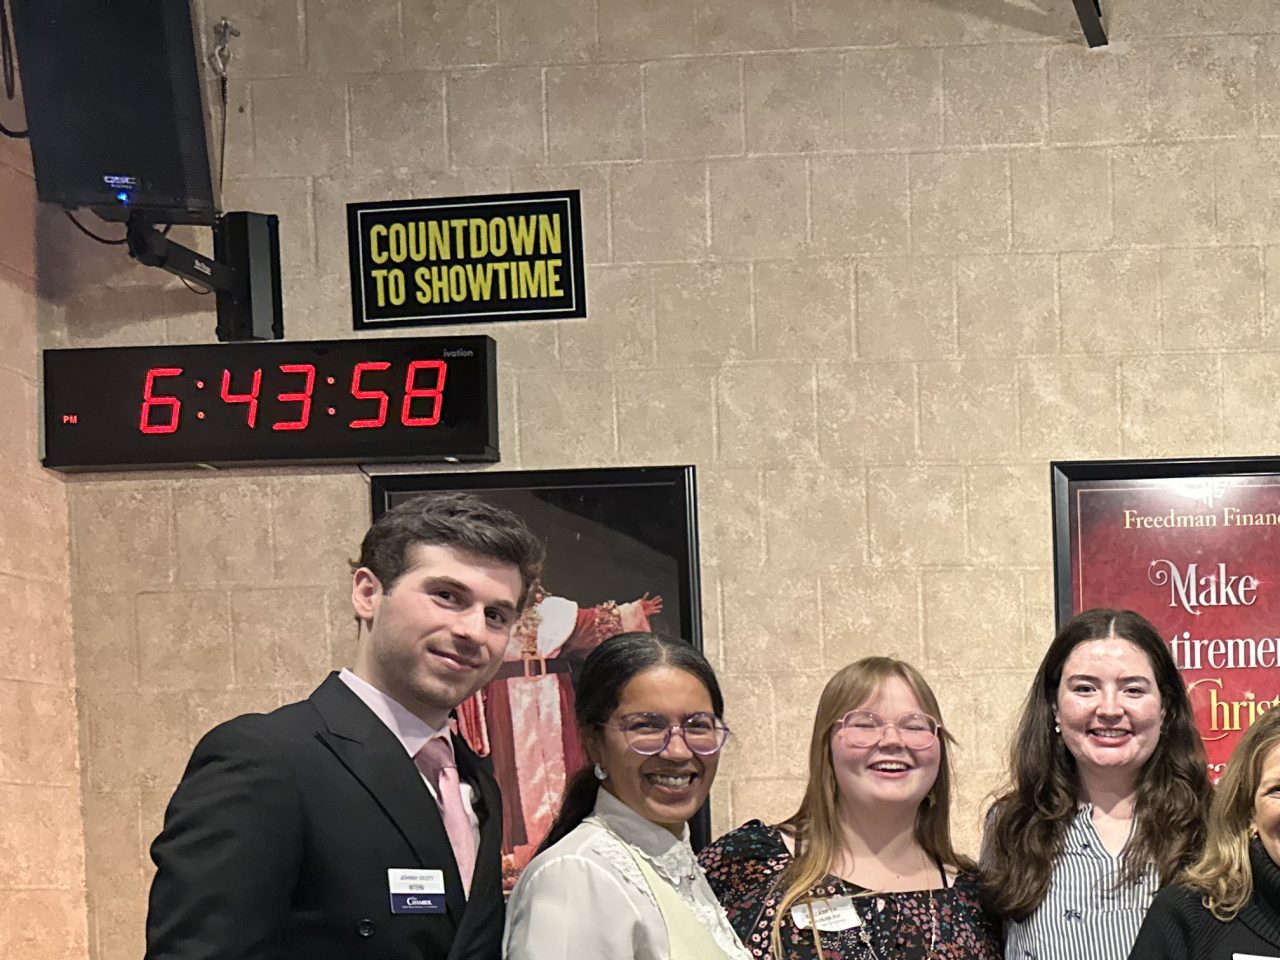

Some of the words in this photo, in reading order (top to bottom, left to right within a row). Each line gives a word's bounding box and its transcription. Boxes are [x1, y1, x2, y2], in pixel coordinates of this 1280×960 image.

[369, 213, 562, 264] COUNTDOWN
[371, 268, 406, 307] TO
[414, 259, 564, 305] SHOWTIME
[63, 415, 78, 424] PM
[140, 360, 447, 434] 6:43:58
[1123, 509, 1217, 529] Freedman
[1148, 559, 1259, 615] Make
